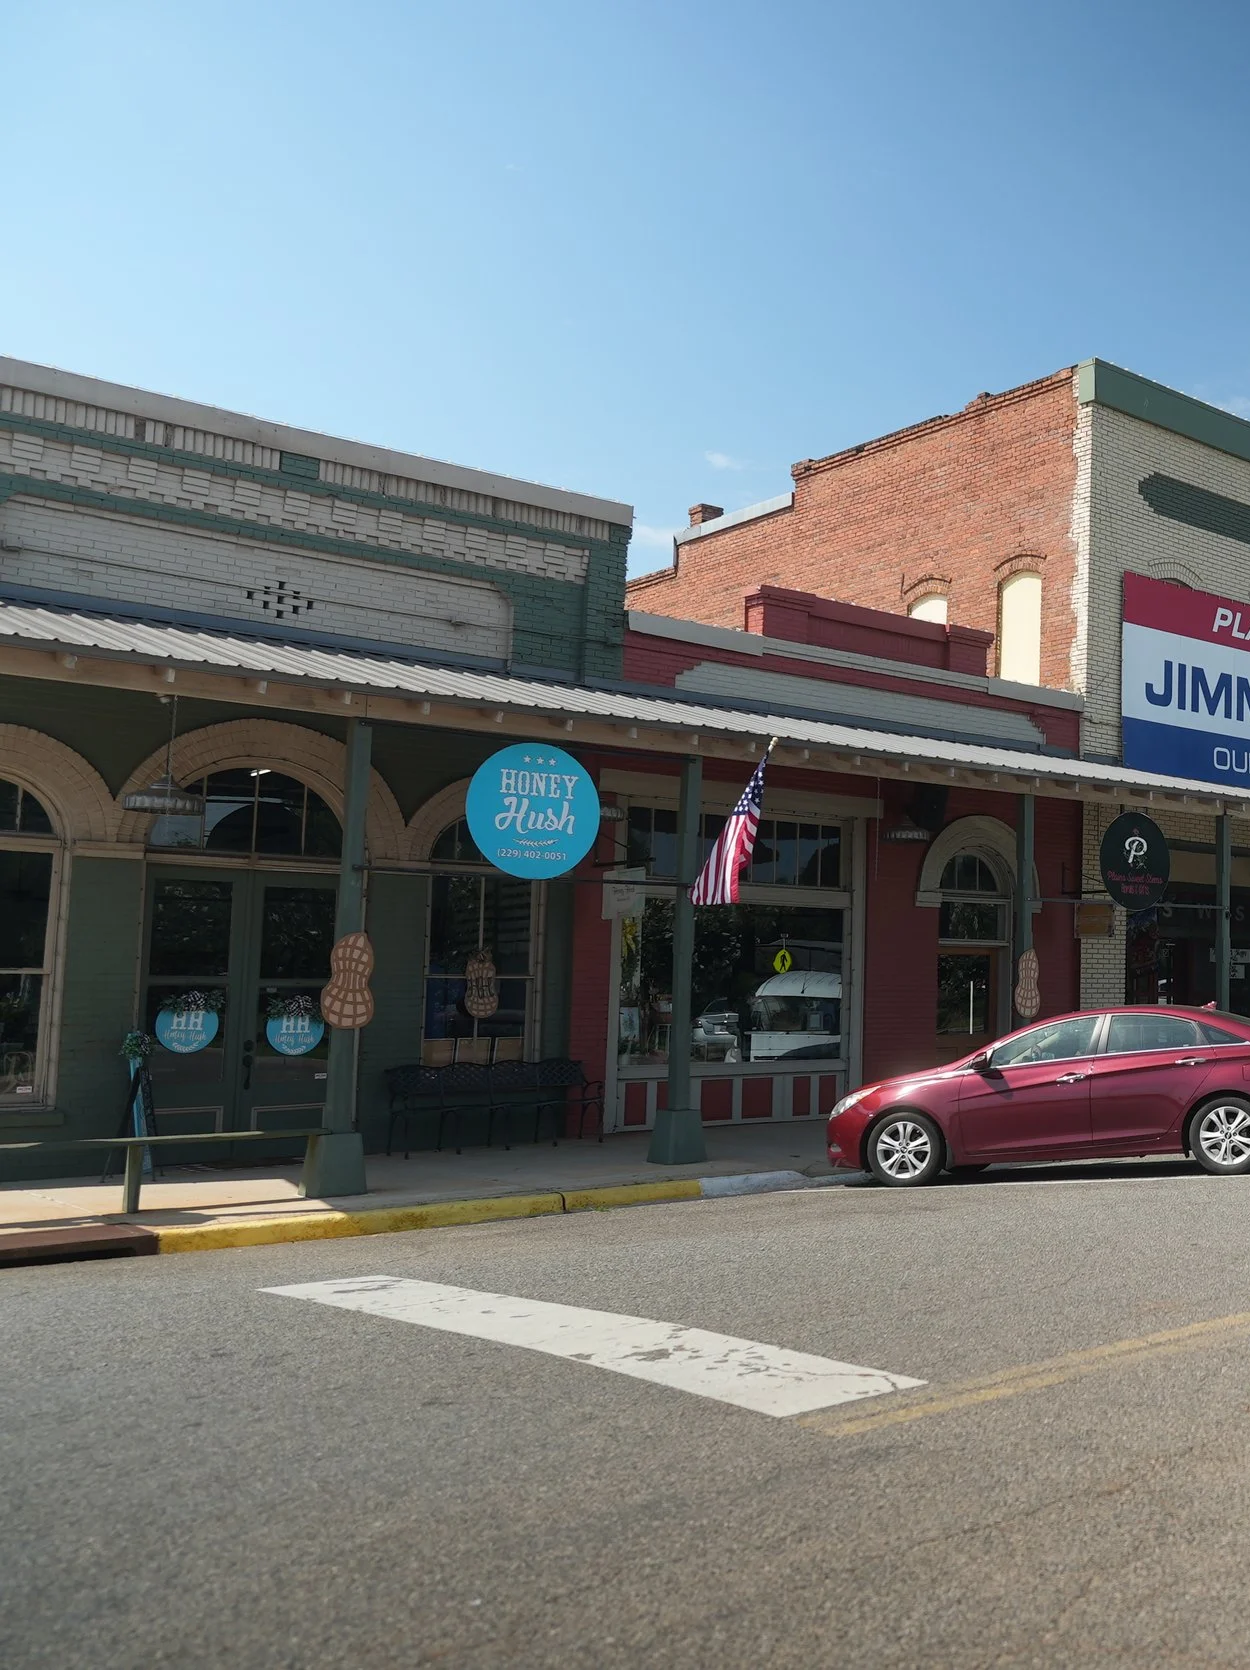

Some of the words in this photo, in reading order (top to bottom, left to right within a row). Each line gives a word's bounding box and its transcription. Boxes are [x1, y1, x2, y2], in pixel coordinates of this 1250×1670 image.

[500, 768, 579, 800] HONEY
[494, 796, 575, 834] Hush
[498, 849, 521, 859] (229)
[524, 850, 567, 861] 402-0051
[171, 1011, 205, 1030] HH
